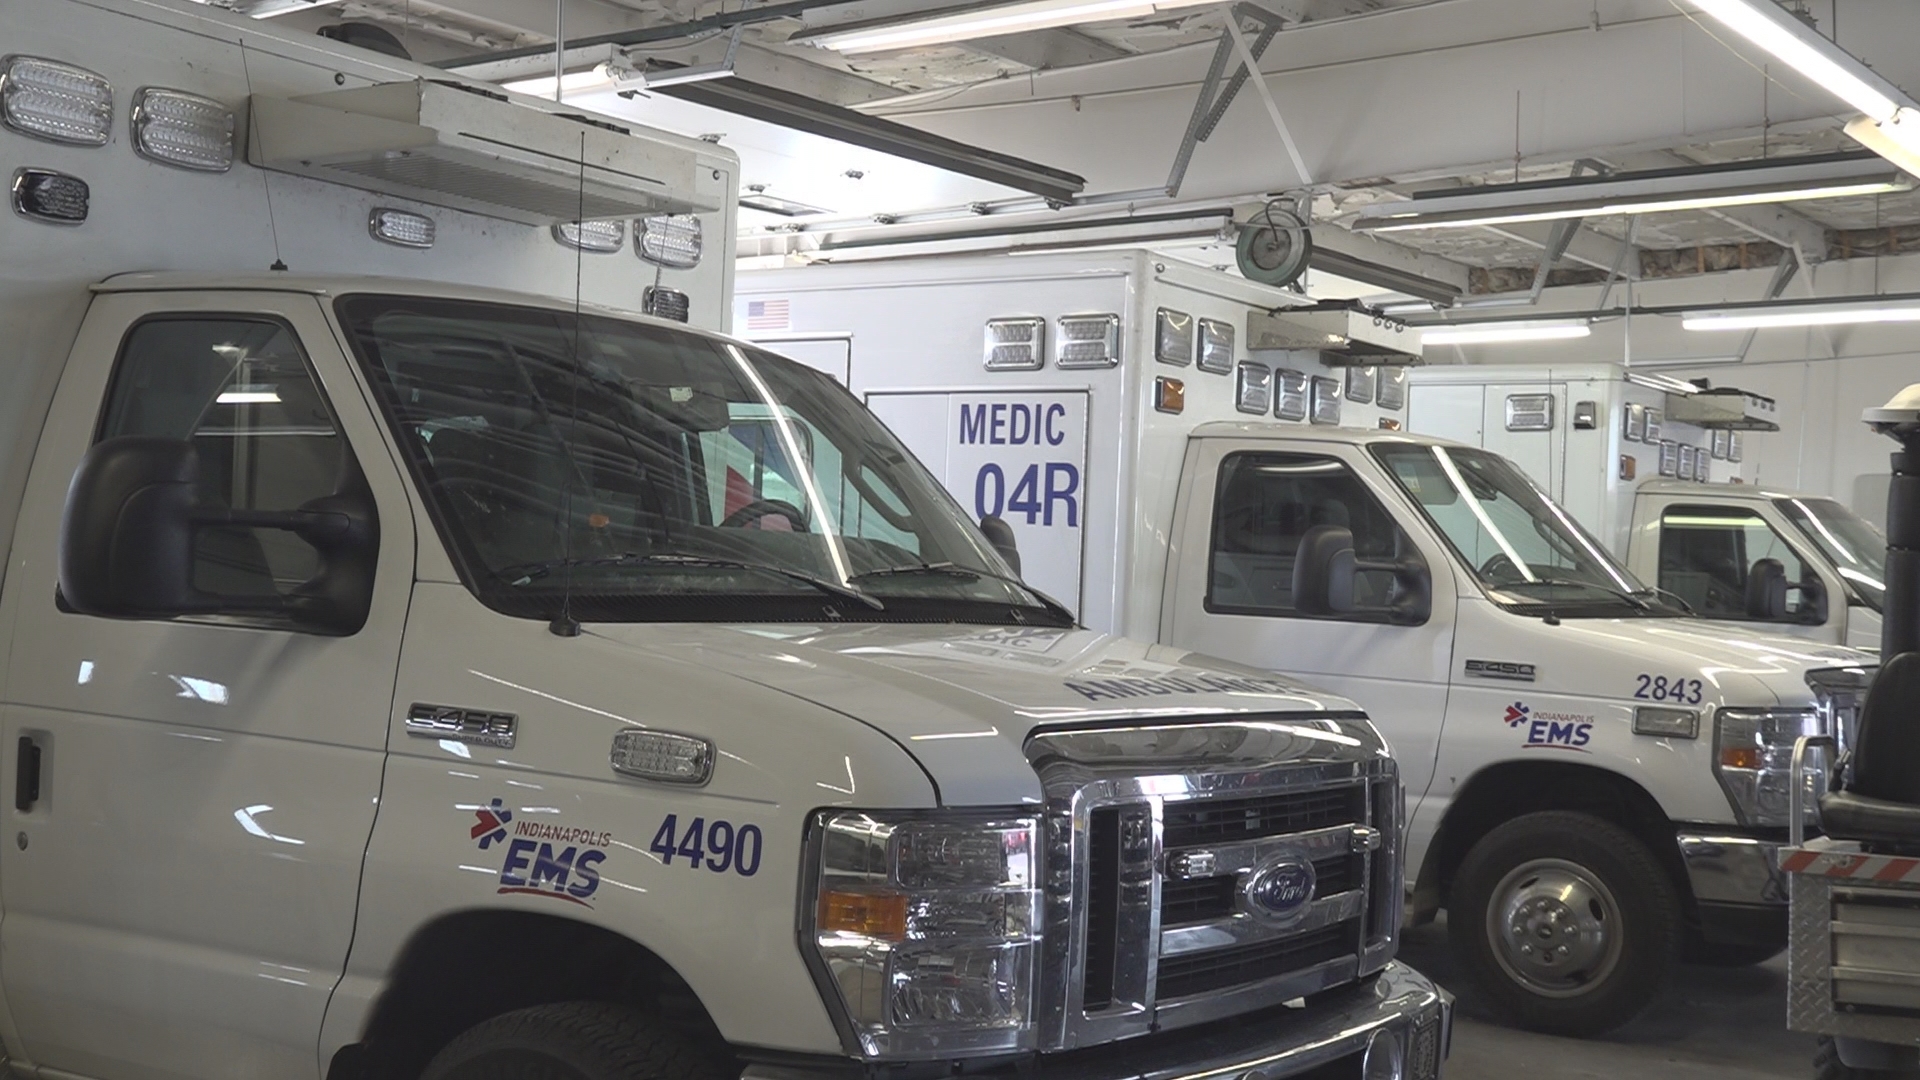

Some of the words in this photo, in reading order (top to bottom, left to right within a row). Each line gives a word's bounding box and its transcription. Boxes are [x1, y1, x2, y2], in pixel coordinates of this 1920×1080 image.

[959, 403, 1065, 446] MEDIC
[975, 462, 1080, 527] 04R
[1634, 674, 1702, 704] 2843
[1532, 711, 1595, 723] INDIANAPOLIS
[1527, 721, 1593, 746] EMS
[514, 820, 612, 848] INDIANAPOLIS
[650, 814, 763, 877] 4490
[500, 839, 608, 899] EMS
[1273, 871, 1306, 901] Ford
